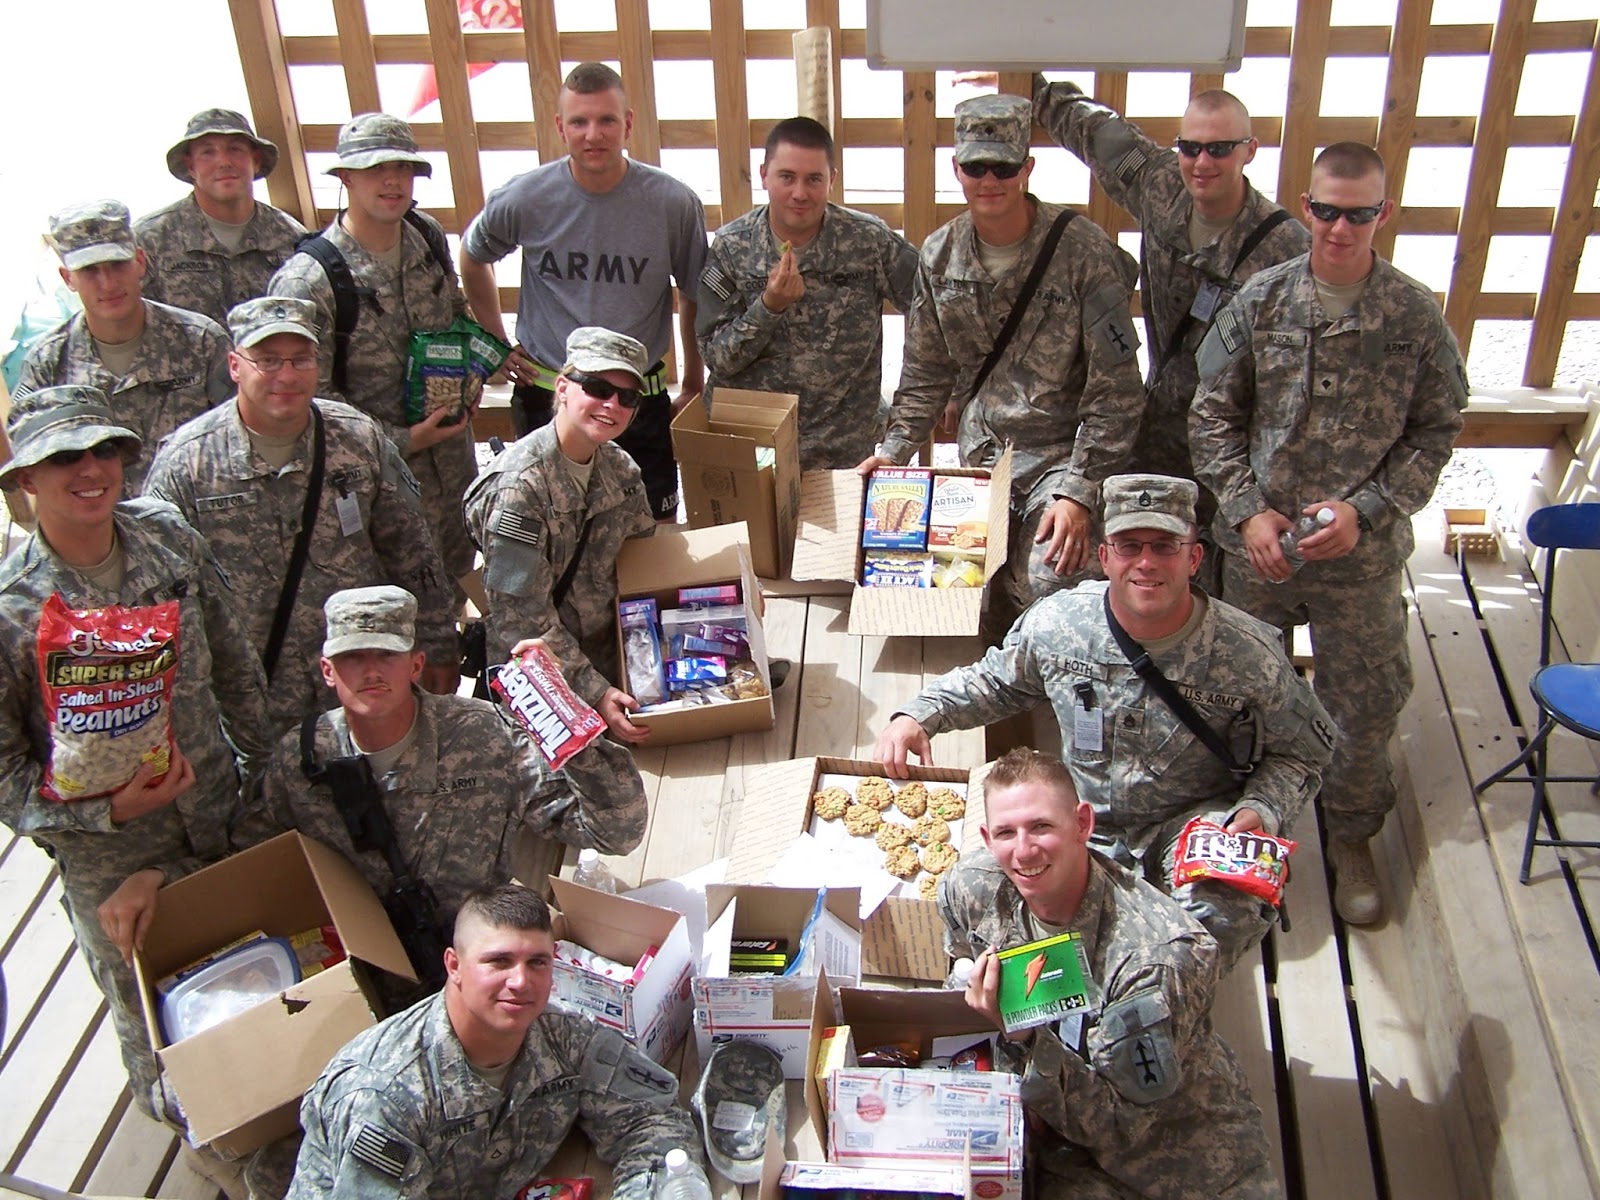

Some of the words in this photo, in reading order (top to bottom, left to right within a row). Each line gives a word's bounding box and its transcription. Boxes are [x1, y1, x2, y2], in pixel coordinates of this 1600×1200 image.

[538, 249, 649, 284] ARMY
[1267, 333, 1293, 344] MASON
[1384, 342, 1413, 353] ARMY
[873, 470, 904, 479] VALUE
[905, 470, 930, 479] SIZE
[210, 494, 245, 508] TUTOR
[933, 496, 974, 507] ARTISAN
[58, 664, 123, 685] SUPER
[129, 649, 174, 681] SIZE
[1064, 660, 1094, 675] HOTH
[59, 690, 104, 707] Salted
[108, 677, 165, 702] In-Shell
[1185, 688, 1205, 702] U.S.
[1207, 694, 1241, 709] ARMY
[56, 694, 161, 733] Peanuts
[451, 776, 478, 791] ARMY
[1012, 1004, 1038, 1022] POWDER
[1039, 1000, 1059, 1017] PACKS
[541, 1078, 575, 1096] ARMY
[440, 1123, 475, 1141] WHITE
[945, 1129, 967, 1138] MAIL
